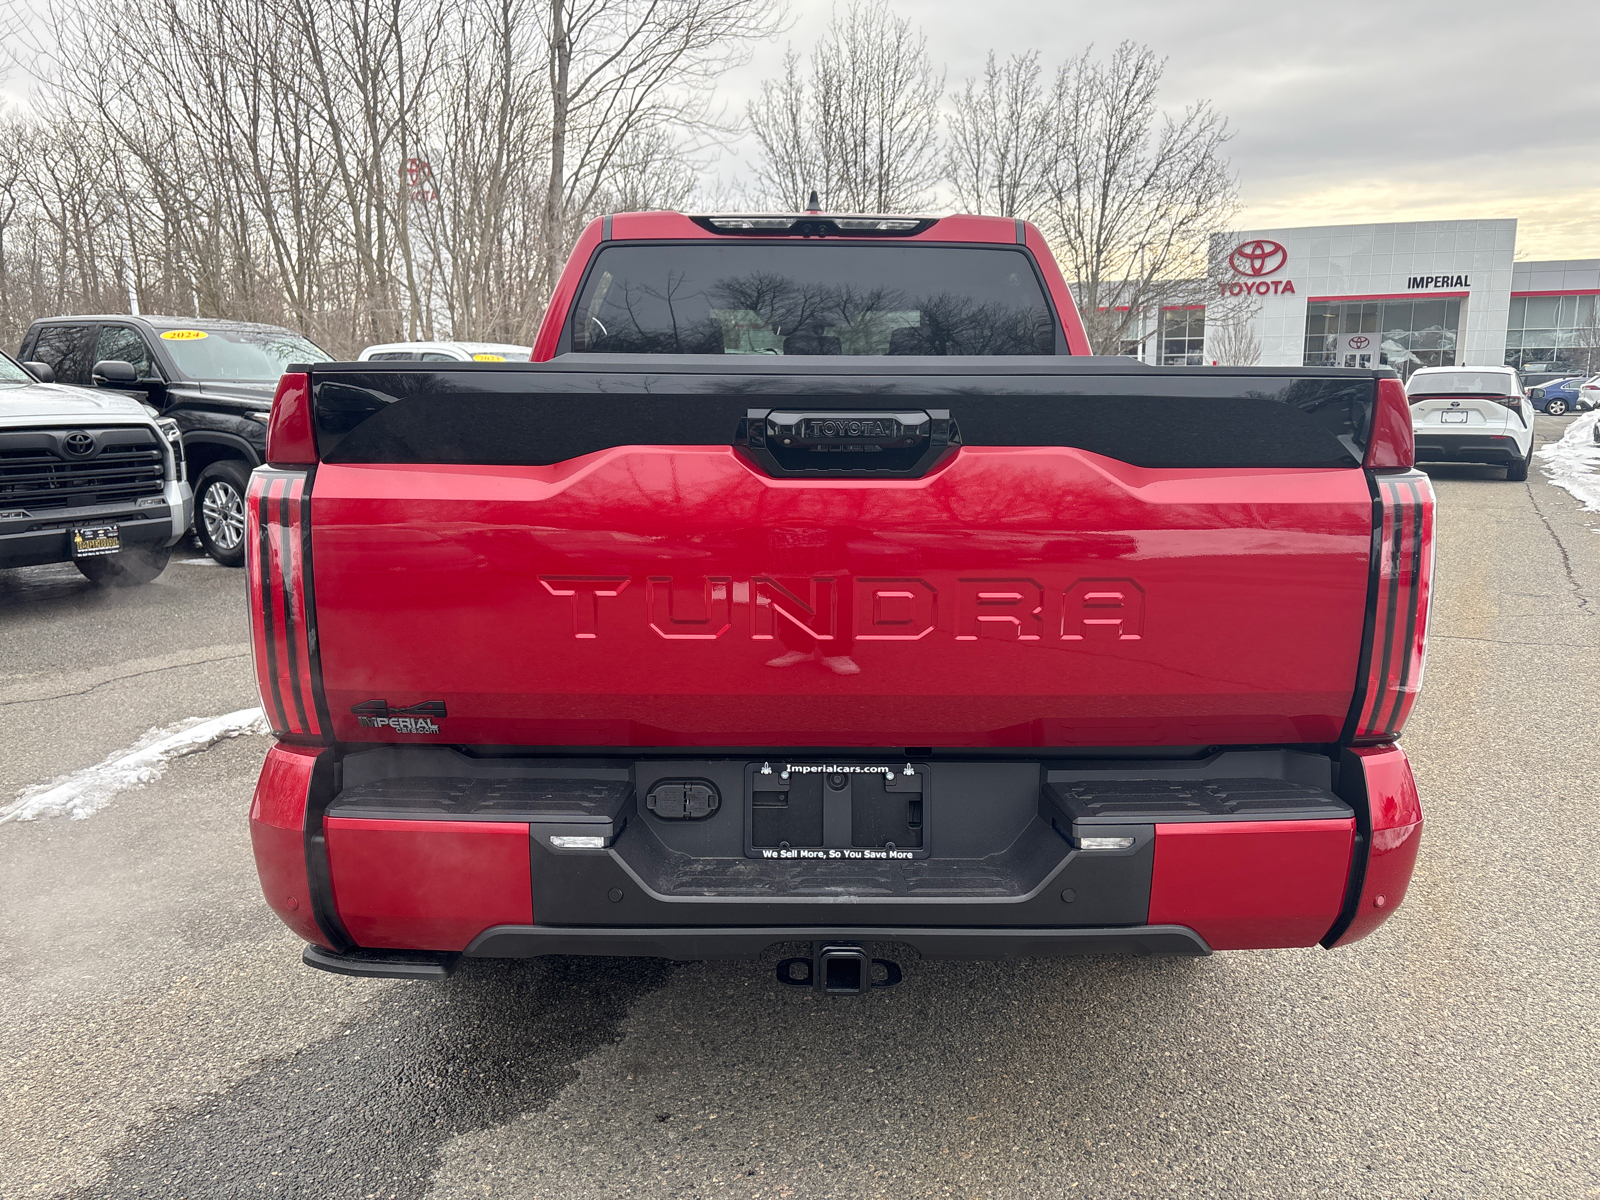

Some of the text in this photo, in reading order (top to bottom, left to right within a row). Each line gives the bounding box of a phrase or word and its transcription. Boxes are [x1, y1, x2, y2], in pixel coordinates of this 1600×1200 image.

[1219, 280, 1296, 297] TOYOTA
[1407, 275, 1471, 289] IMPERIAL
[169, 331, 200, 339] 2024
[811, 420, 887, 436] TOYOTA
[537, 575, 1147, 642] TUNDRA
[358, 716, 439, 729] IMPERIAL
[786, 764, 889, 774] Imperialcars.com
[762, 849, 913, 860] We Sell More, So You Save More
